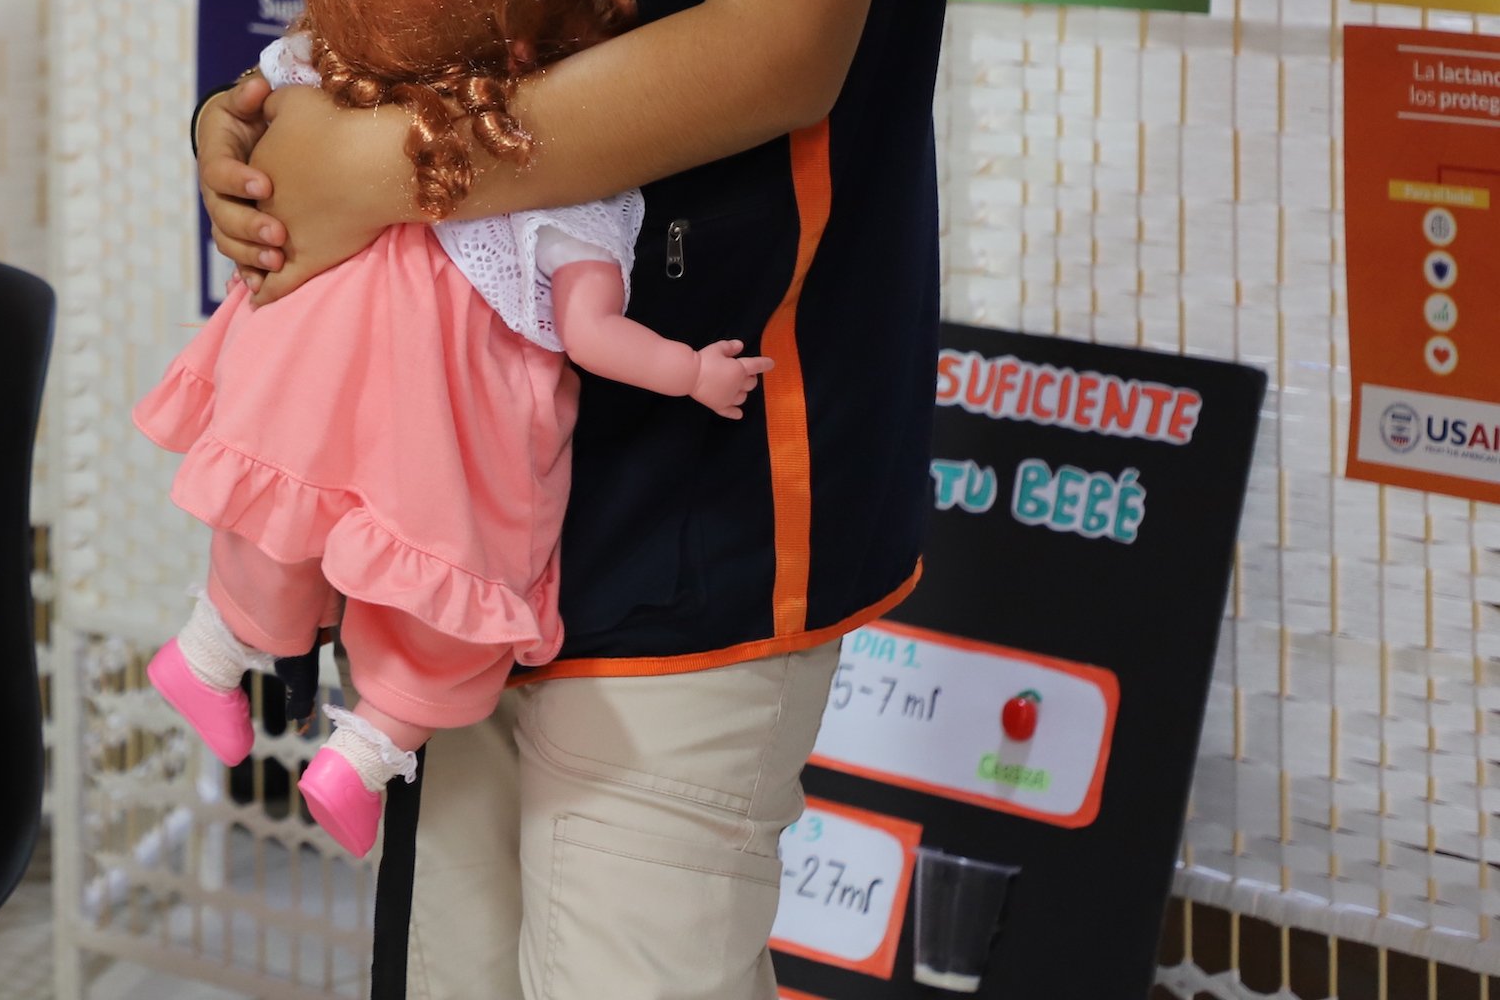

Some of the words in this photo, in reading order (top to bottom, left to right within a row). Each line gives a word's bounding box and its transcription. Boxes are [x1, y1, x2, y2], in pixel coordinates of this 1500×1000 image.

[1413, 60, 1435, 81] La
[1409, 84, 1436, 107] los
[936, 353, 1202, 442] SUFICIENTE
[932, 460, 993, 507] TU
[1015, 463, 1144, 541] BEBÉ
[852, 629, 897, 663] DIA
[902, 641, 922, 669] 1
[803, 816, 825, 842] 3
